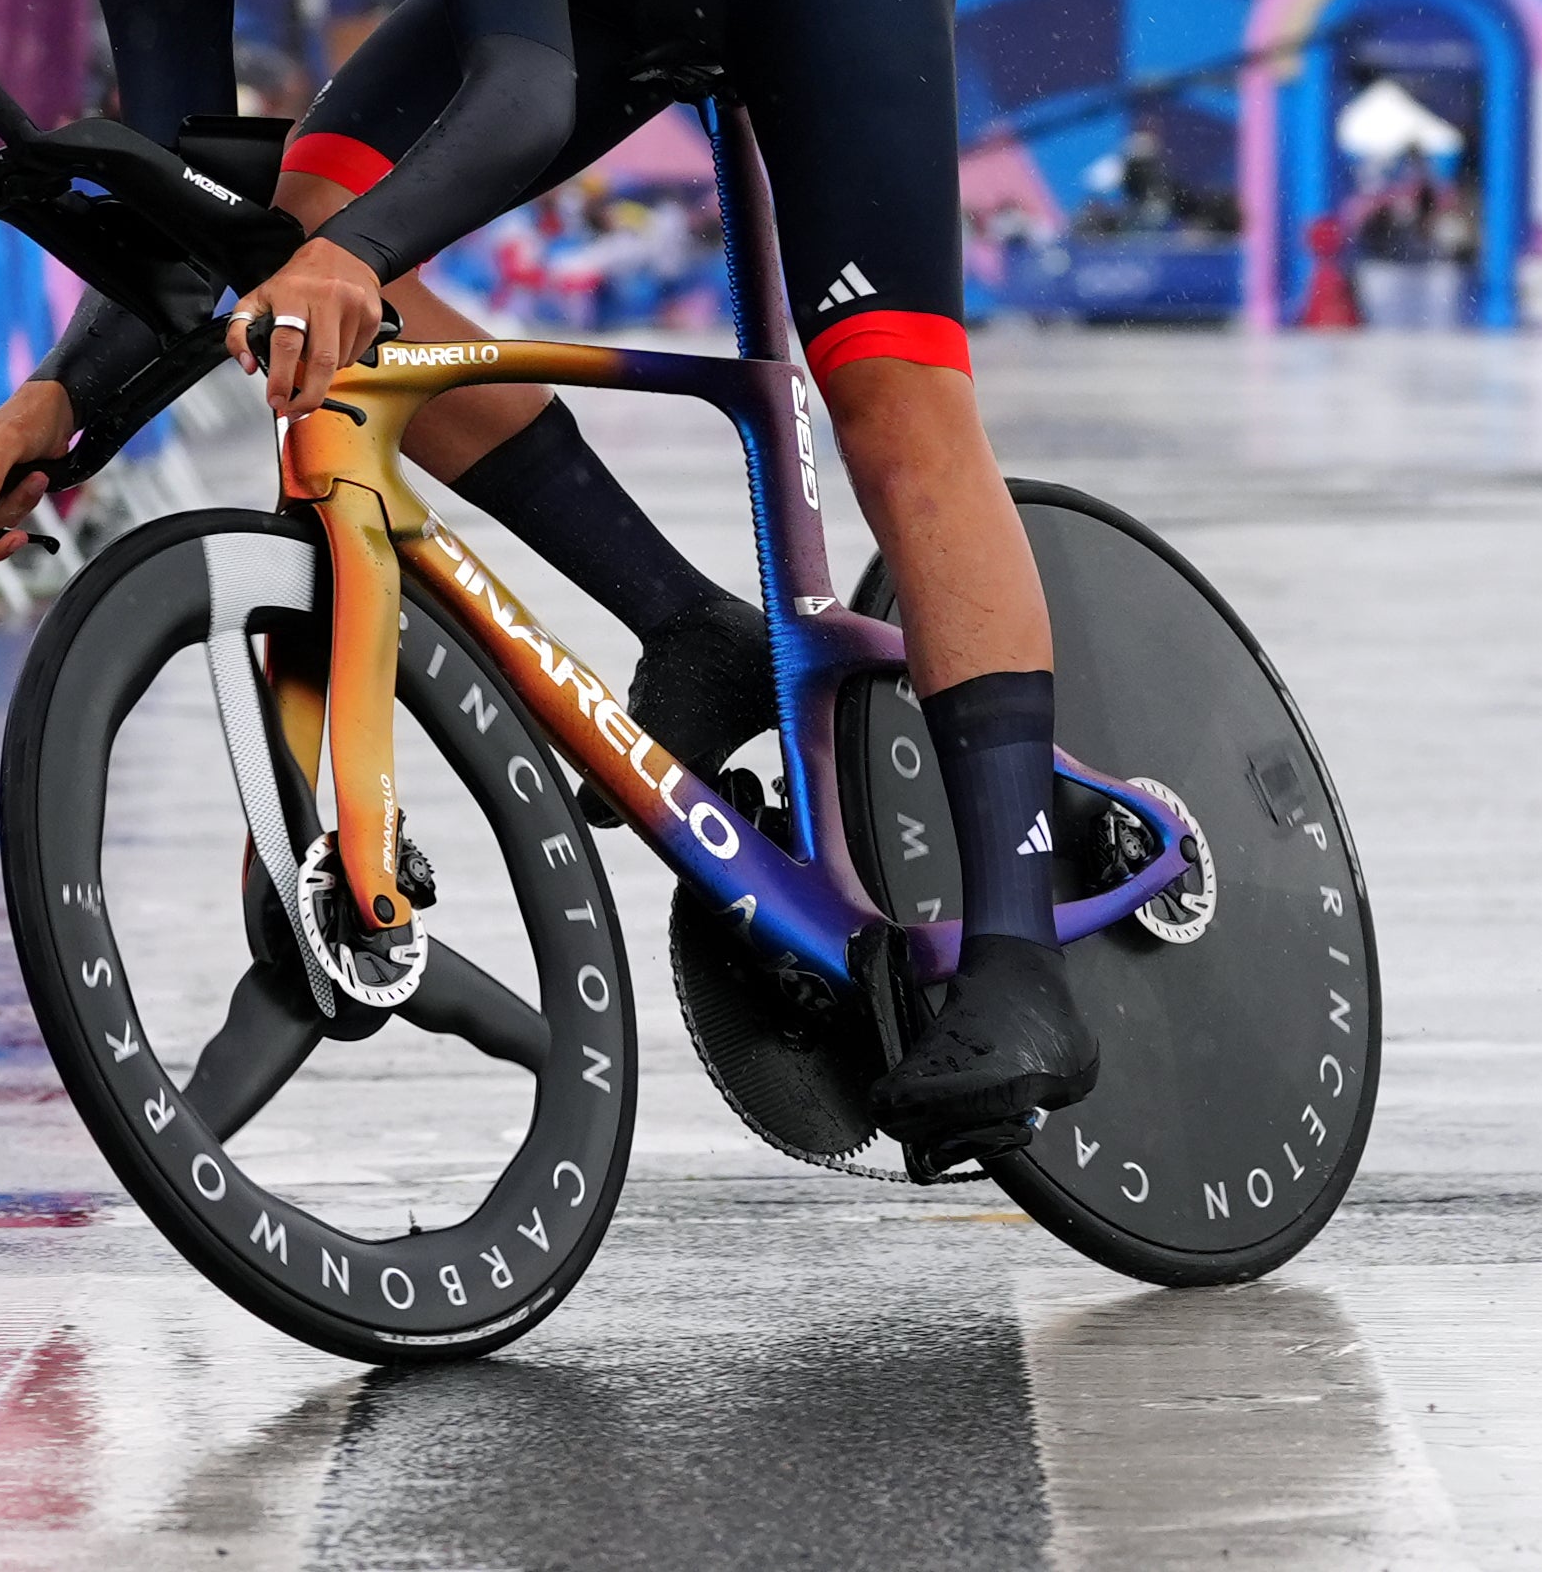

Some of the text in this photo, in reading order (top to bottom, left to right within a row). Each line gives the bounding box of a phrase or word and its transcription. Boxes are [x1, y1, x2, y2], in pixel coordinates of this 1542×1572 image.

[382, 344, 500, 367] PINARELLO
[791, 374, 821, 512] GBR
[421, 508, 740, 860] PINARELLO
[380, 772, 395, 874] PINARELLO
[399, 611, 613, 1094] INCETON
[1202, 821, 1353, 1221] PRINCETON
